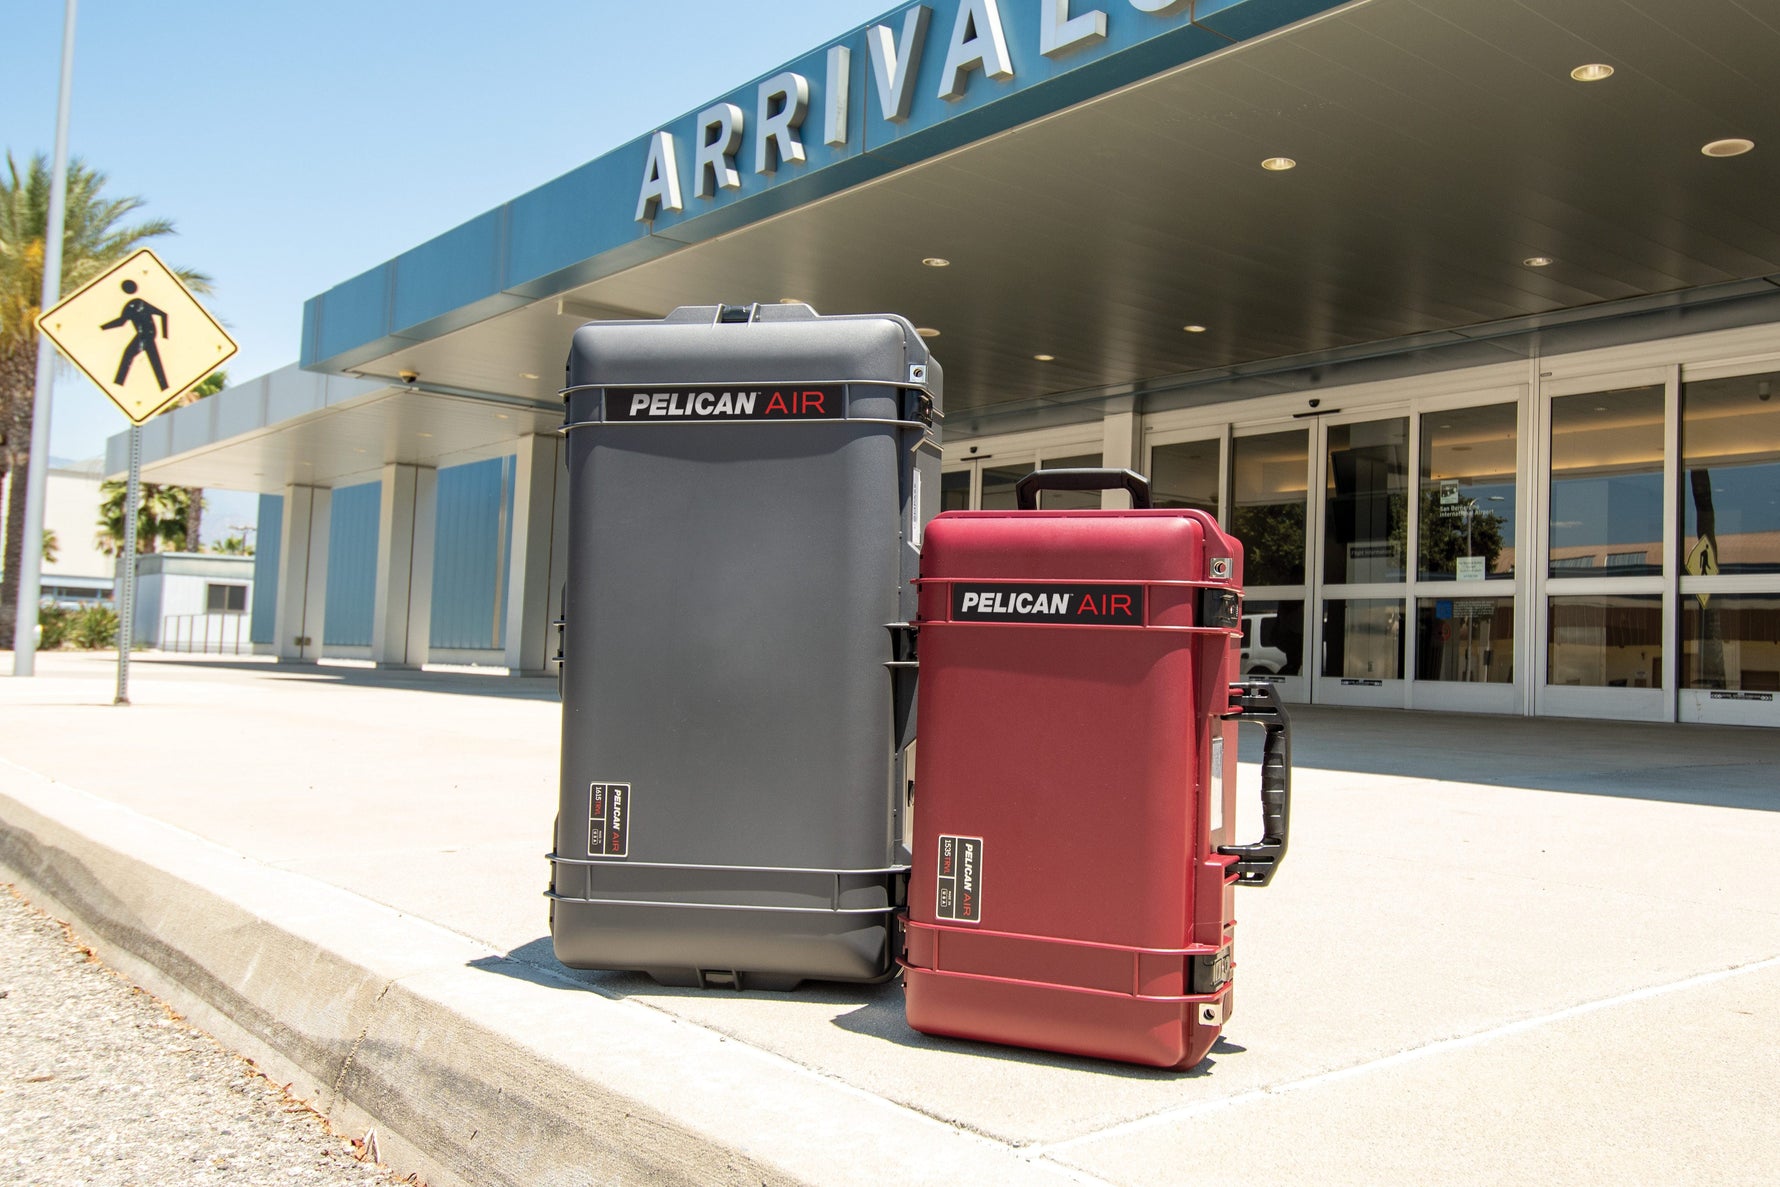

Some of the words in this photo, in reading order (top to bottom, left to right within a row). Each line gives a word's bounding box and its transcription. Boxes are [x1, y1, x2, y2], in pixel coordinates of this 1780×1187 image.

[634, 0, 1188, 223] ARRIVAL
[629, 391, 758, 416] PELICAN
[765, 391, 826, 415] AIR
[961, 592, 1070, 615] PELICAN
[1077, 594, 1133, 616] AIR
[613, 789, 622, 831] PELICAN
[612, 832, 620, 852] AIR
[964, 843, 973, 892] PELICAN
[963, 893, 972, 916] AIR
